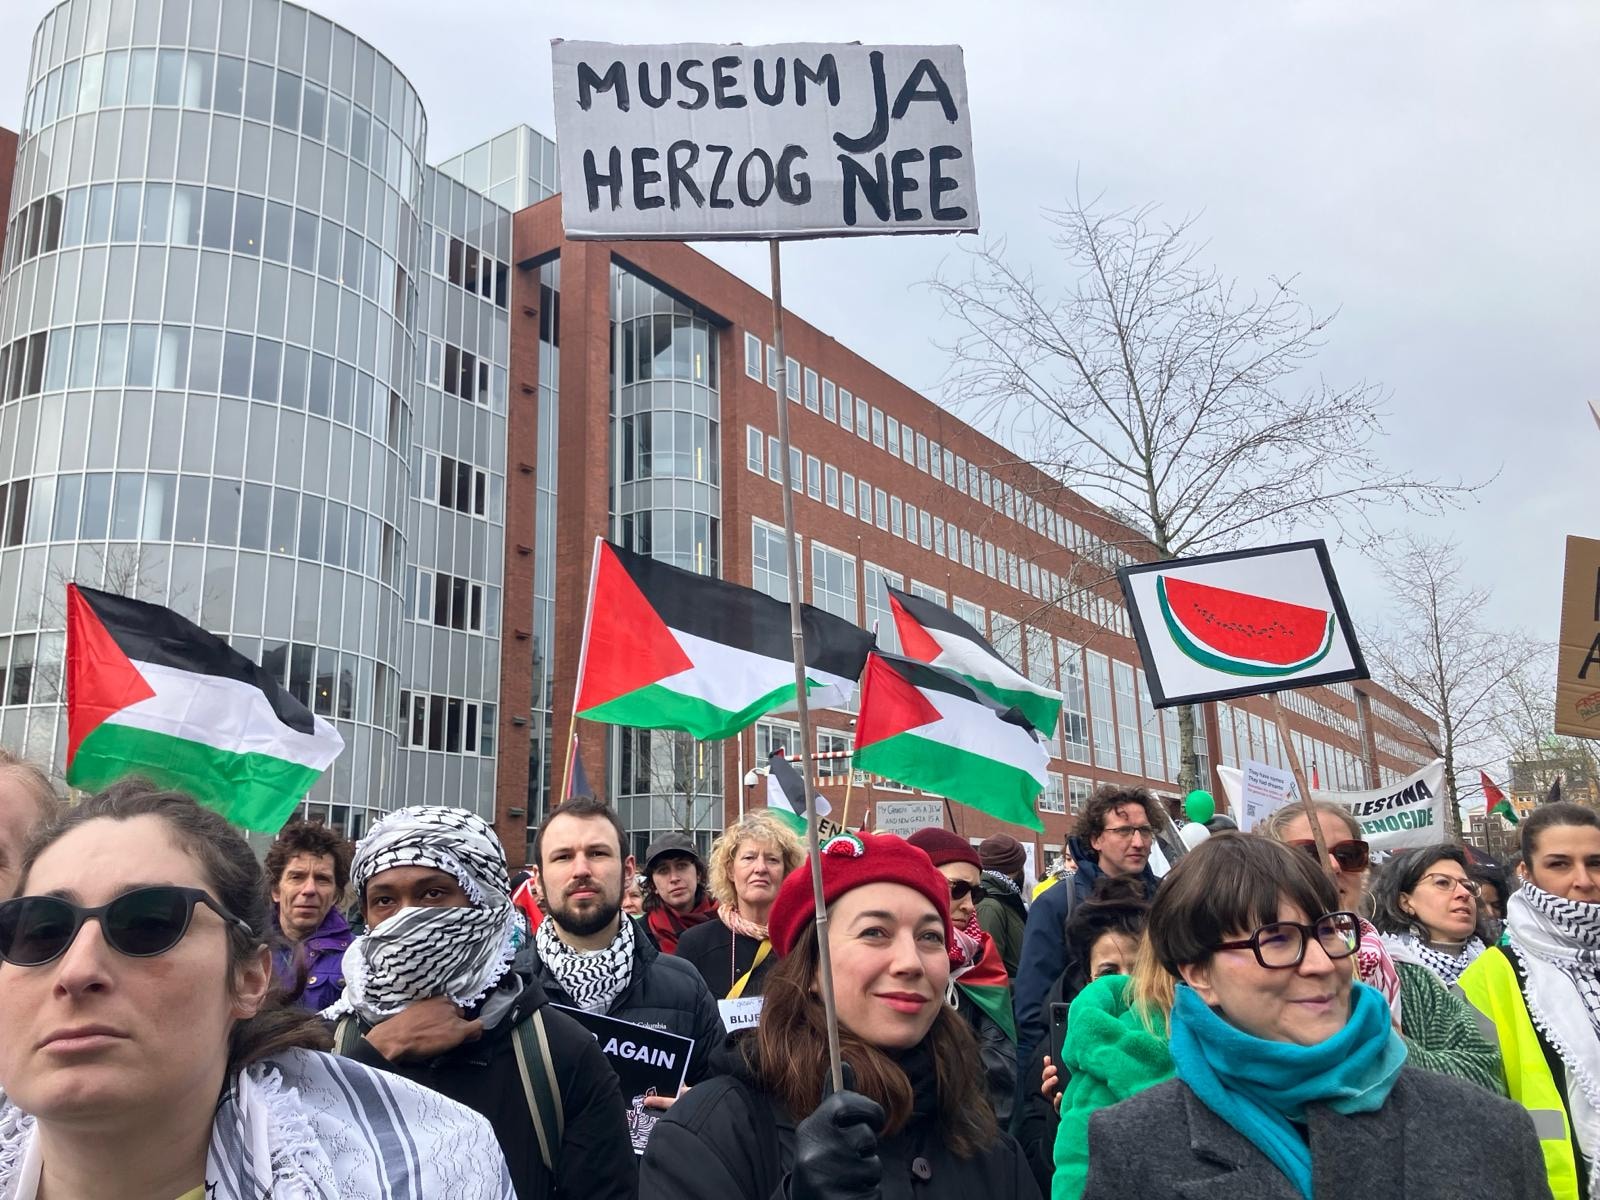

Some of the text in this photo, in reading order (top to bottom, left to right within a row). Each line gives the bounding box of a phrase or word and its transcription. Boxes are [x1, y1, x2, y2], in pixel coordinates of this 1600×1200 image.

[577, 50, 959, 153] MUSEUM JA
[583, 139, 968, 226] HERZOG NEE
[603, 1037, 676, 1070] AGAIN
